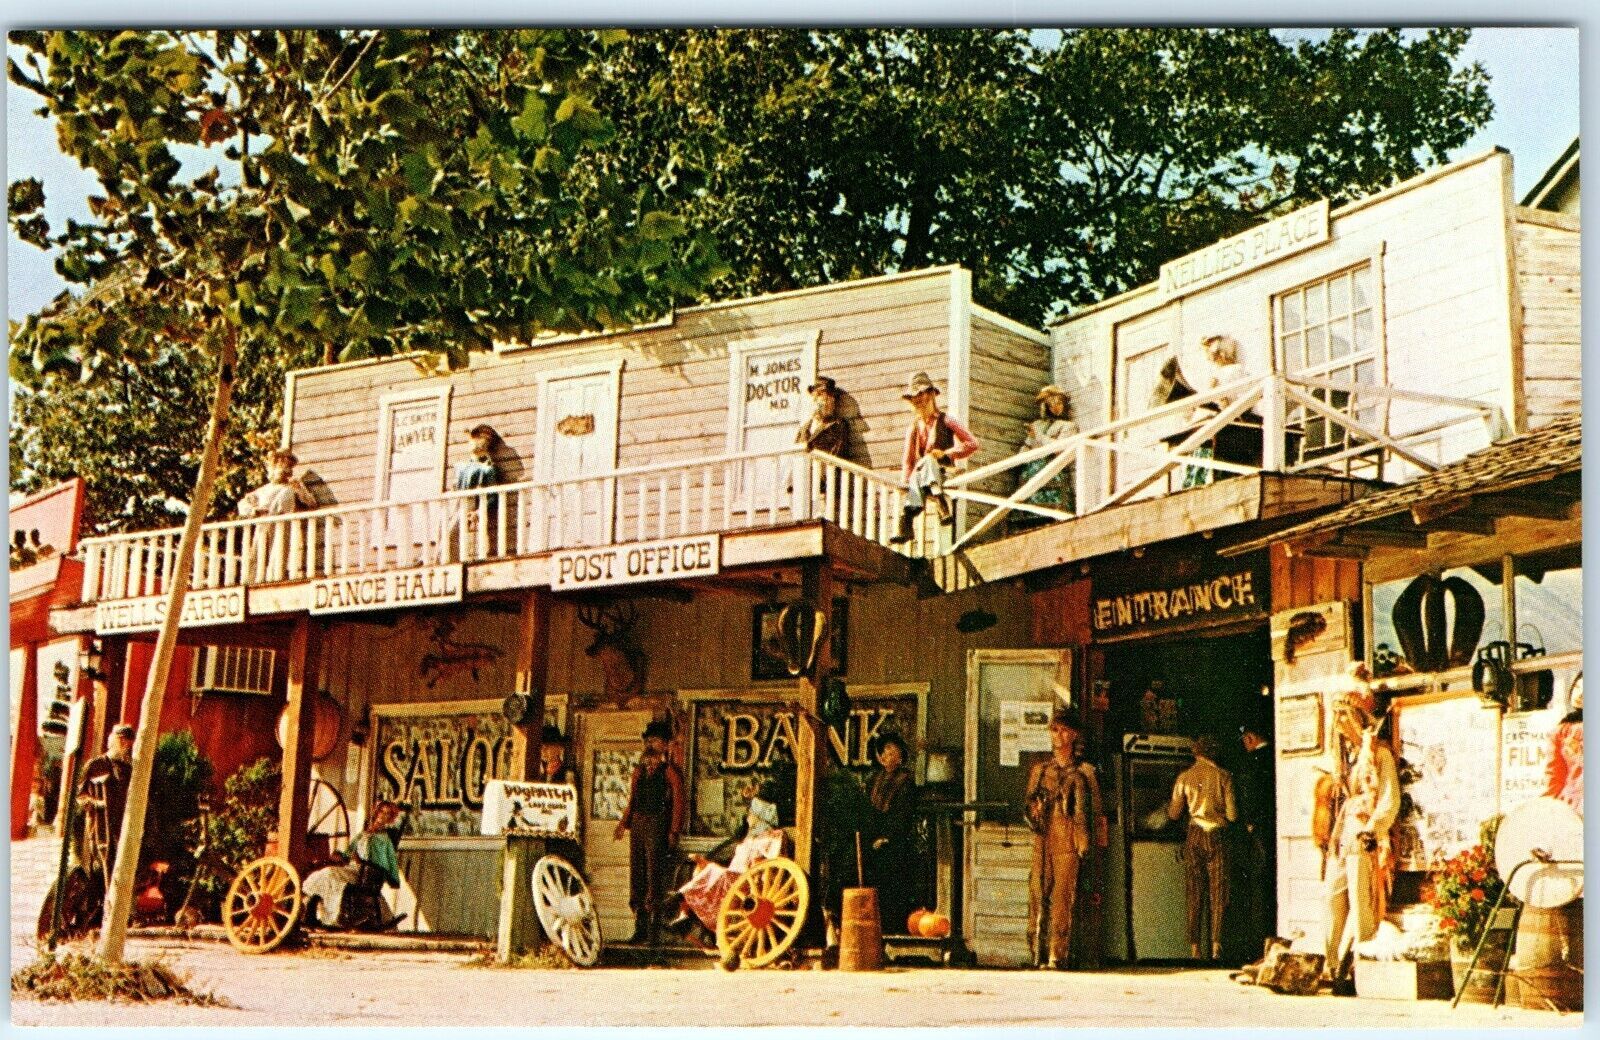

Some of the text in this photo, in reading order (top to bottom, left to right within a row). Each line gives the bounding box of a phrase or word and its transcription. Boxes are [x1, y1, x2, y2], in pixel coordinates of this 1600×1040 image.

[1165, 208, 1319, 294] NELLIES PLACE
[764, 358, 801, 375] JONES
[746, 376, 800, 402] DOCTOR
[559, 541, 711, 585] POST OFFICE
[315, 569, 457, 610] DANCE HALL
[100, 591, 241, 630] WELLS ARGO
[721, 708, 894, 768] BANK
